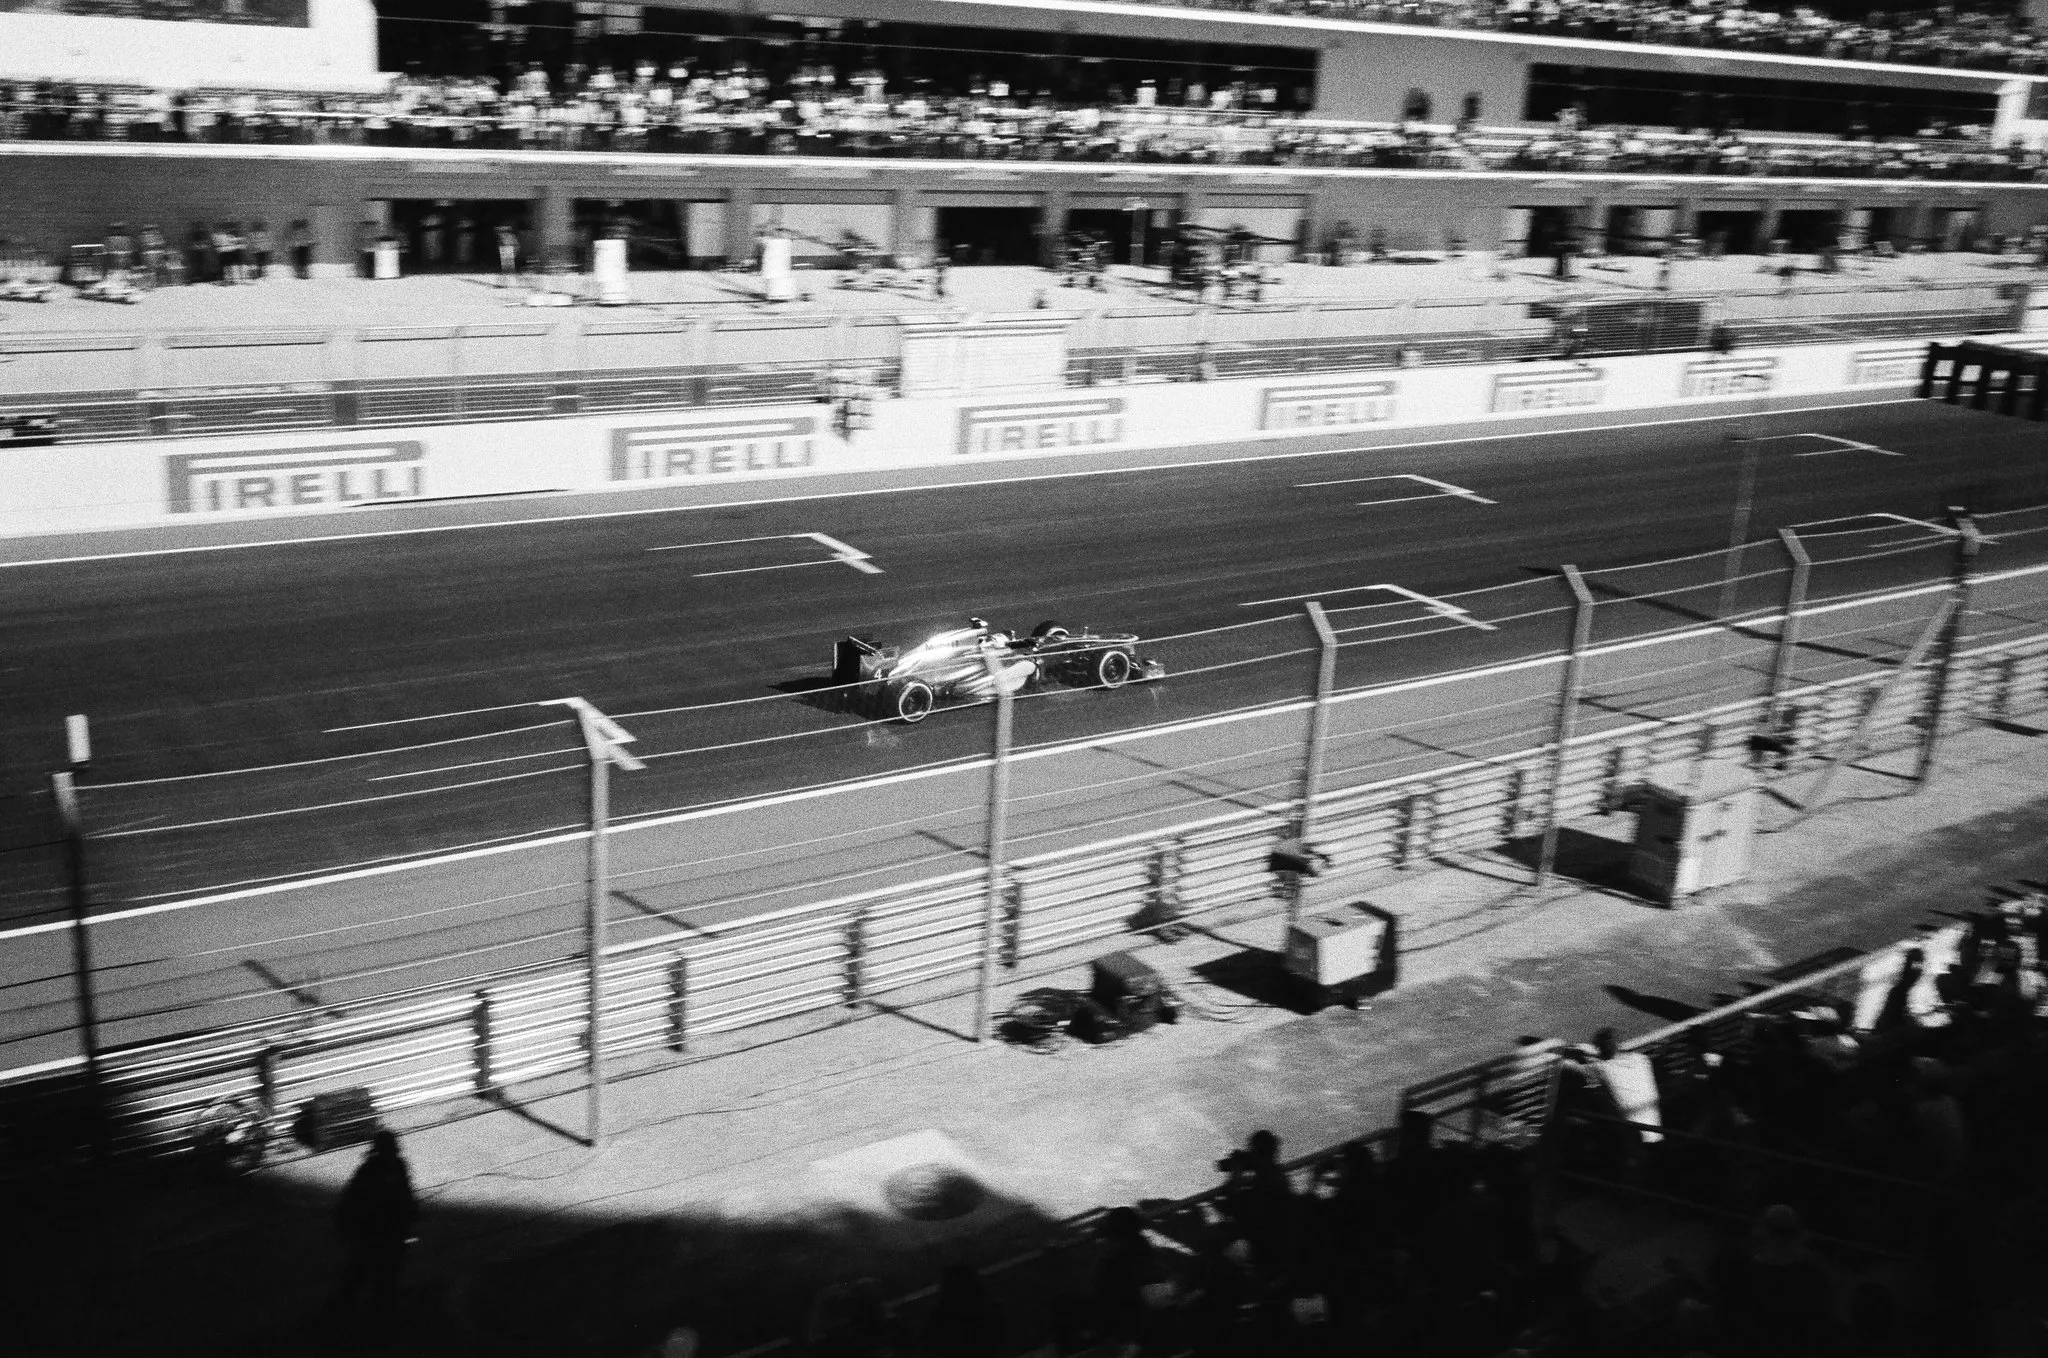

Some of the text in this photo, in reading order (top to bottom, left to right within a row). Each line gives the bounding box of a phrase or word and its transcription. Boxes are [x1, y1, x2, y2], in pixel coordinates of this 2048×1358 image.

[609, 416, 817, 482] PIRELLI
[957, 397, 1125, 454] PIRELLI
[163, 440, 426, 514] PIRELLI
[873, 667, 883, 681] 4
